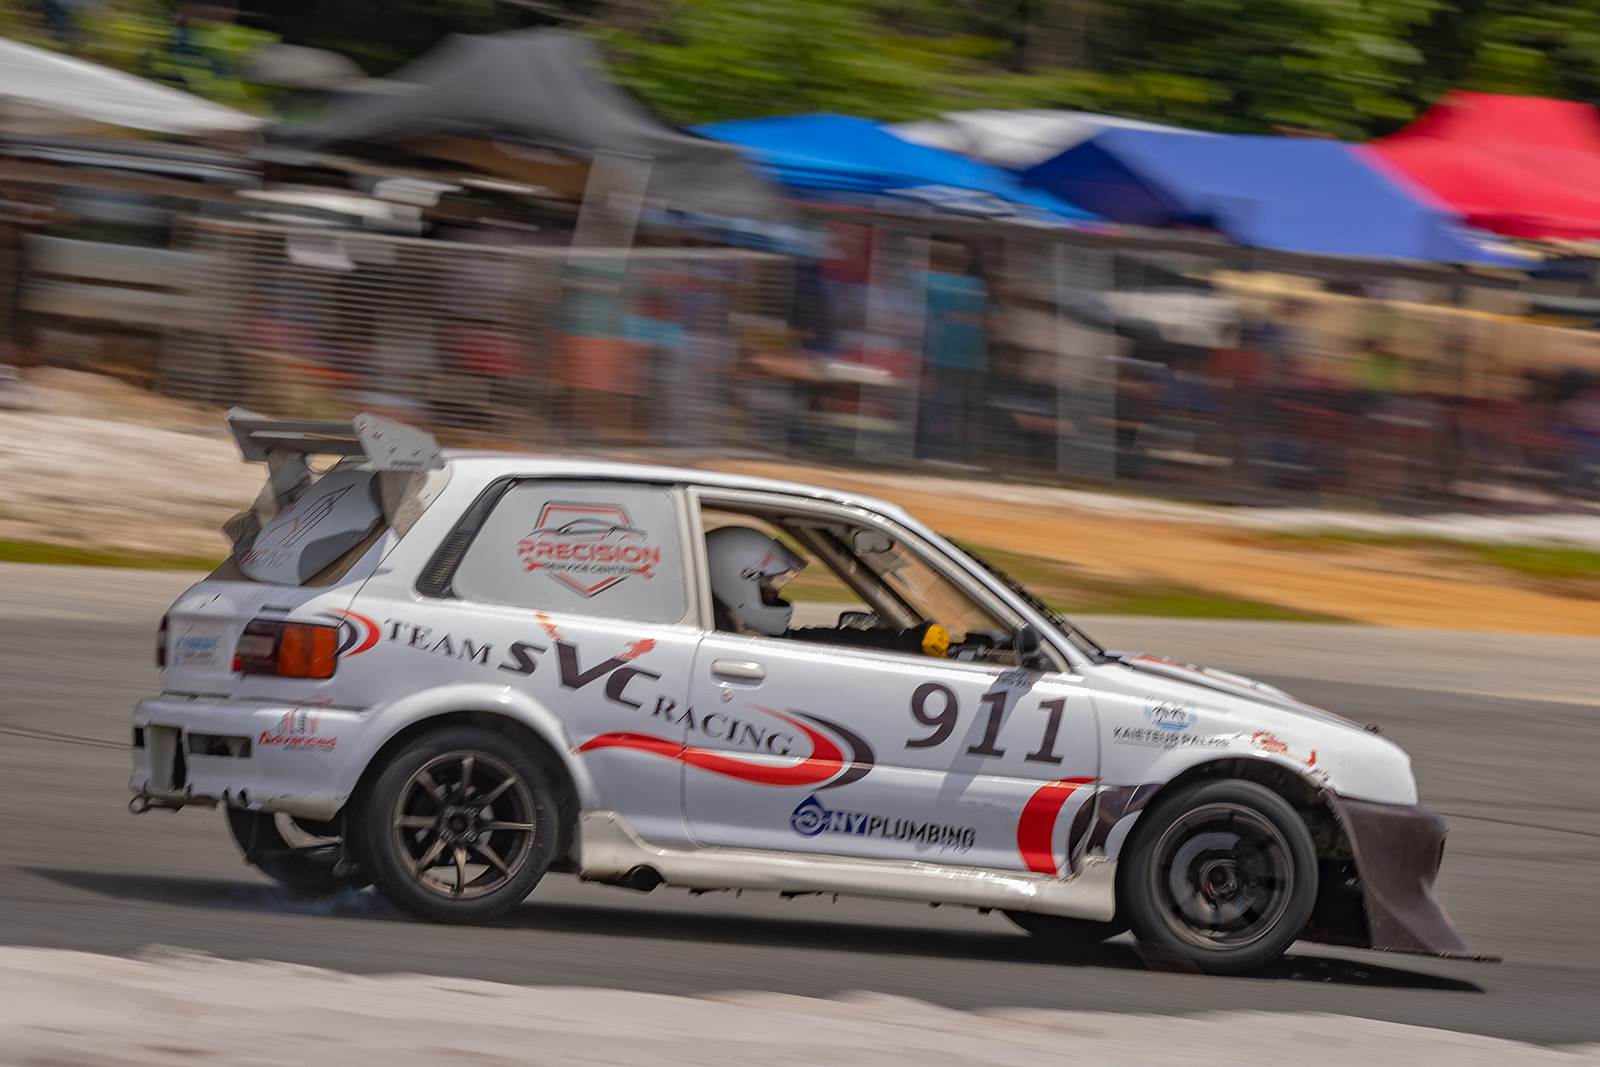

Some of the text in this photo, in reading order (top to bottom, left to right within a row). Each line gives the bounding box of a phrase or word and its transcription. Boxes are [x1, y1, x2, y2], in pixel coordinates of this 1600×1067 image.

[516, 539, 661, 564] PRECISION
[383, 617, 795, 756] TEAM SVC RACING
[904, 682, 1068, 766] 911
[826, 810, 870, 835] NY
[866, 814, 978, 848] PLUMBING
